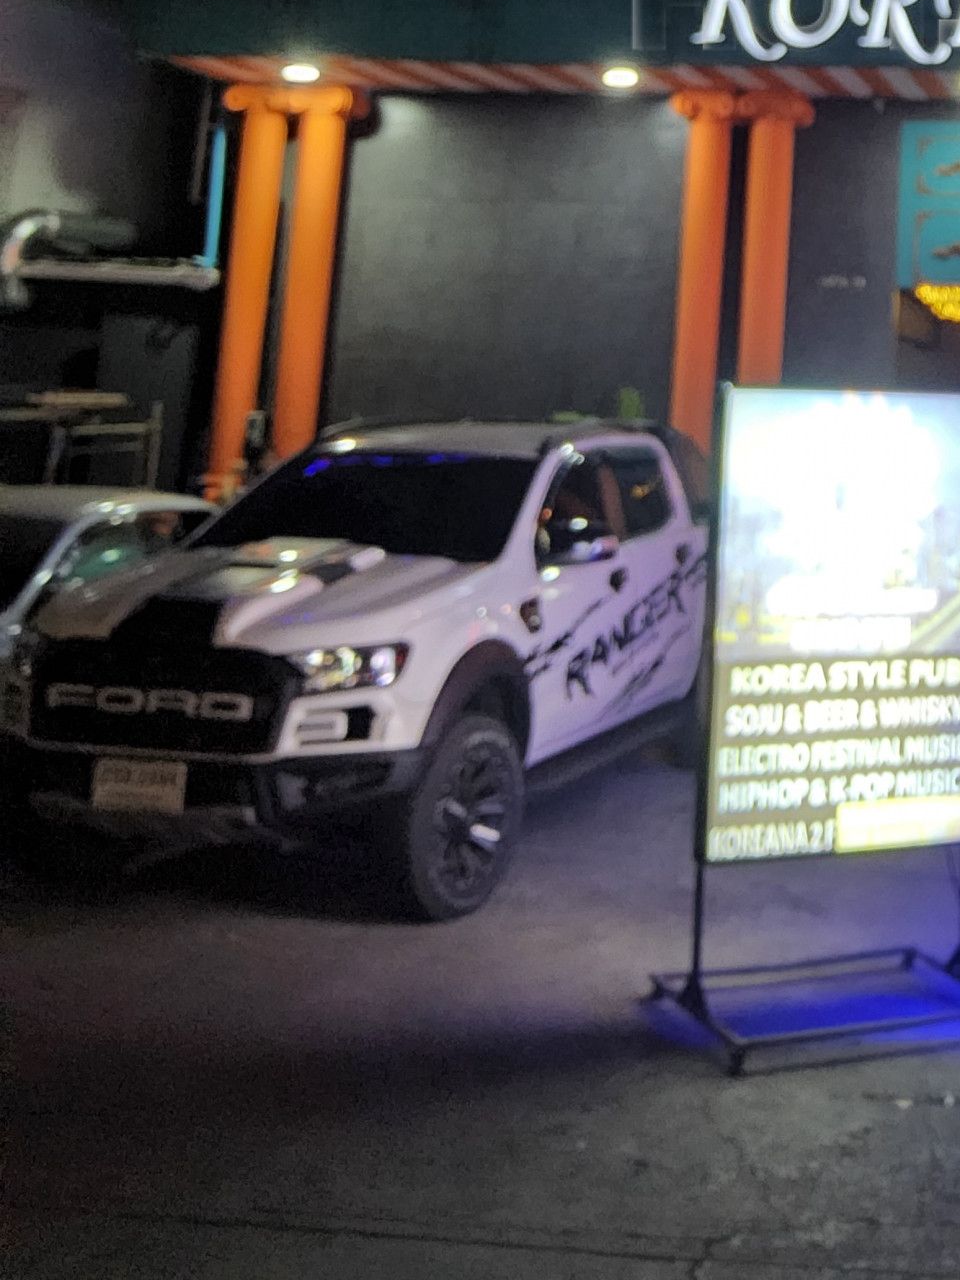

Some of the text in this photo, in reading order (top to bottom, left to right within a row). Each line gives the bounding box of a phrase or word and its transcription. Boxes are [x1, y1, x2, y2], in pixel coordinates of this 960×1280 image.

[565, 571, 686, 701] RANGER
[730, 662, 827, 695] KOREA
[827, 659, 907, 692] STYLE
[47, 682, 253, 720] FORD
[725, 703, 783, 737] SOJU
[784, 702, 802, 734] &
[803, 698, 858, 733] BEER
[859, 699, 878, 730] &
[718, 743, 809, 777] ELECTRO
[810, 737, 901, 771] FESTIVAL
[719, 776, 808, 815] HIPHOP
[808, 777, 827, 806] &
